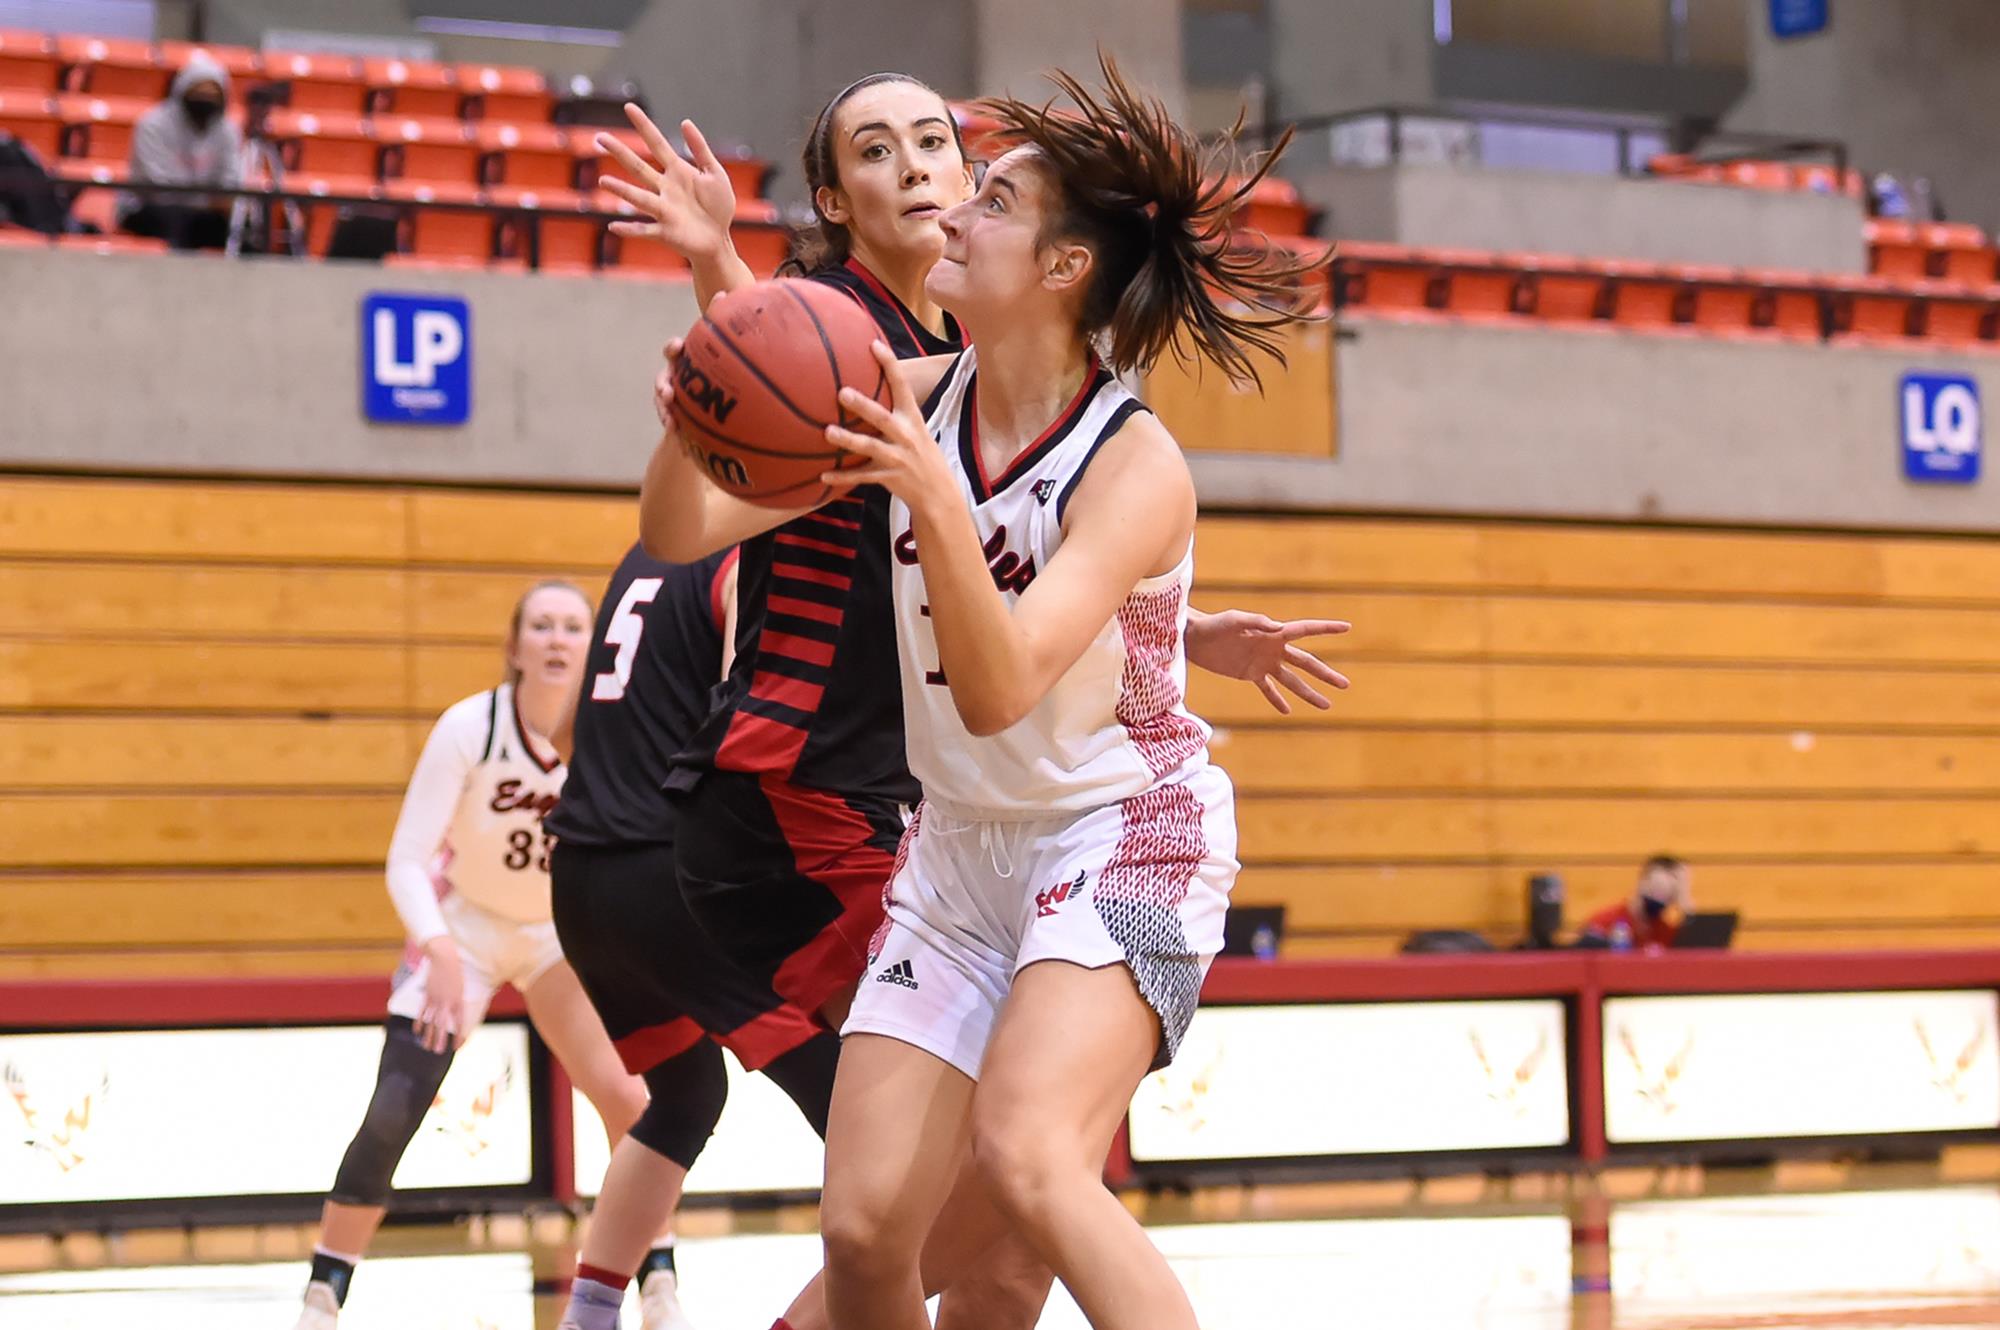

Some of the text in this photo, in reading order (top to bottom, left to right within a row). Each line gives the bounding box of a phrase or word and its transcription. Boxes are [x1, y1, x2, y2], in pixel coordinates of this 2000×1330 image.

[374, 306, 463, 388] LP
[591, 577, 664, 701] 5
[876, 973, 919, 990] adidas
